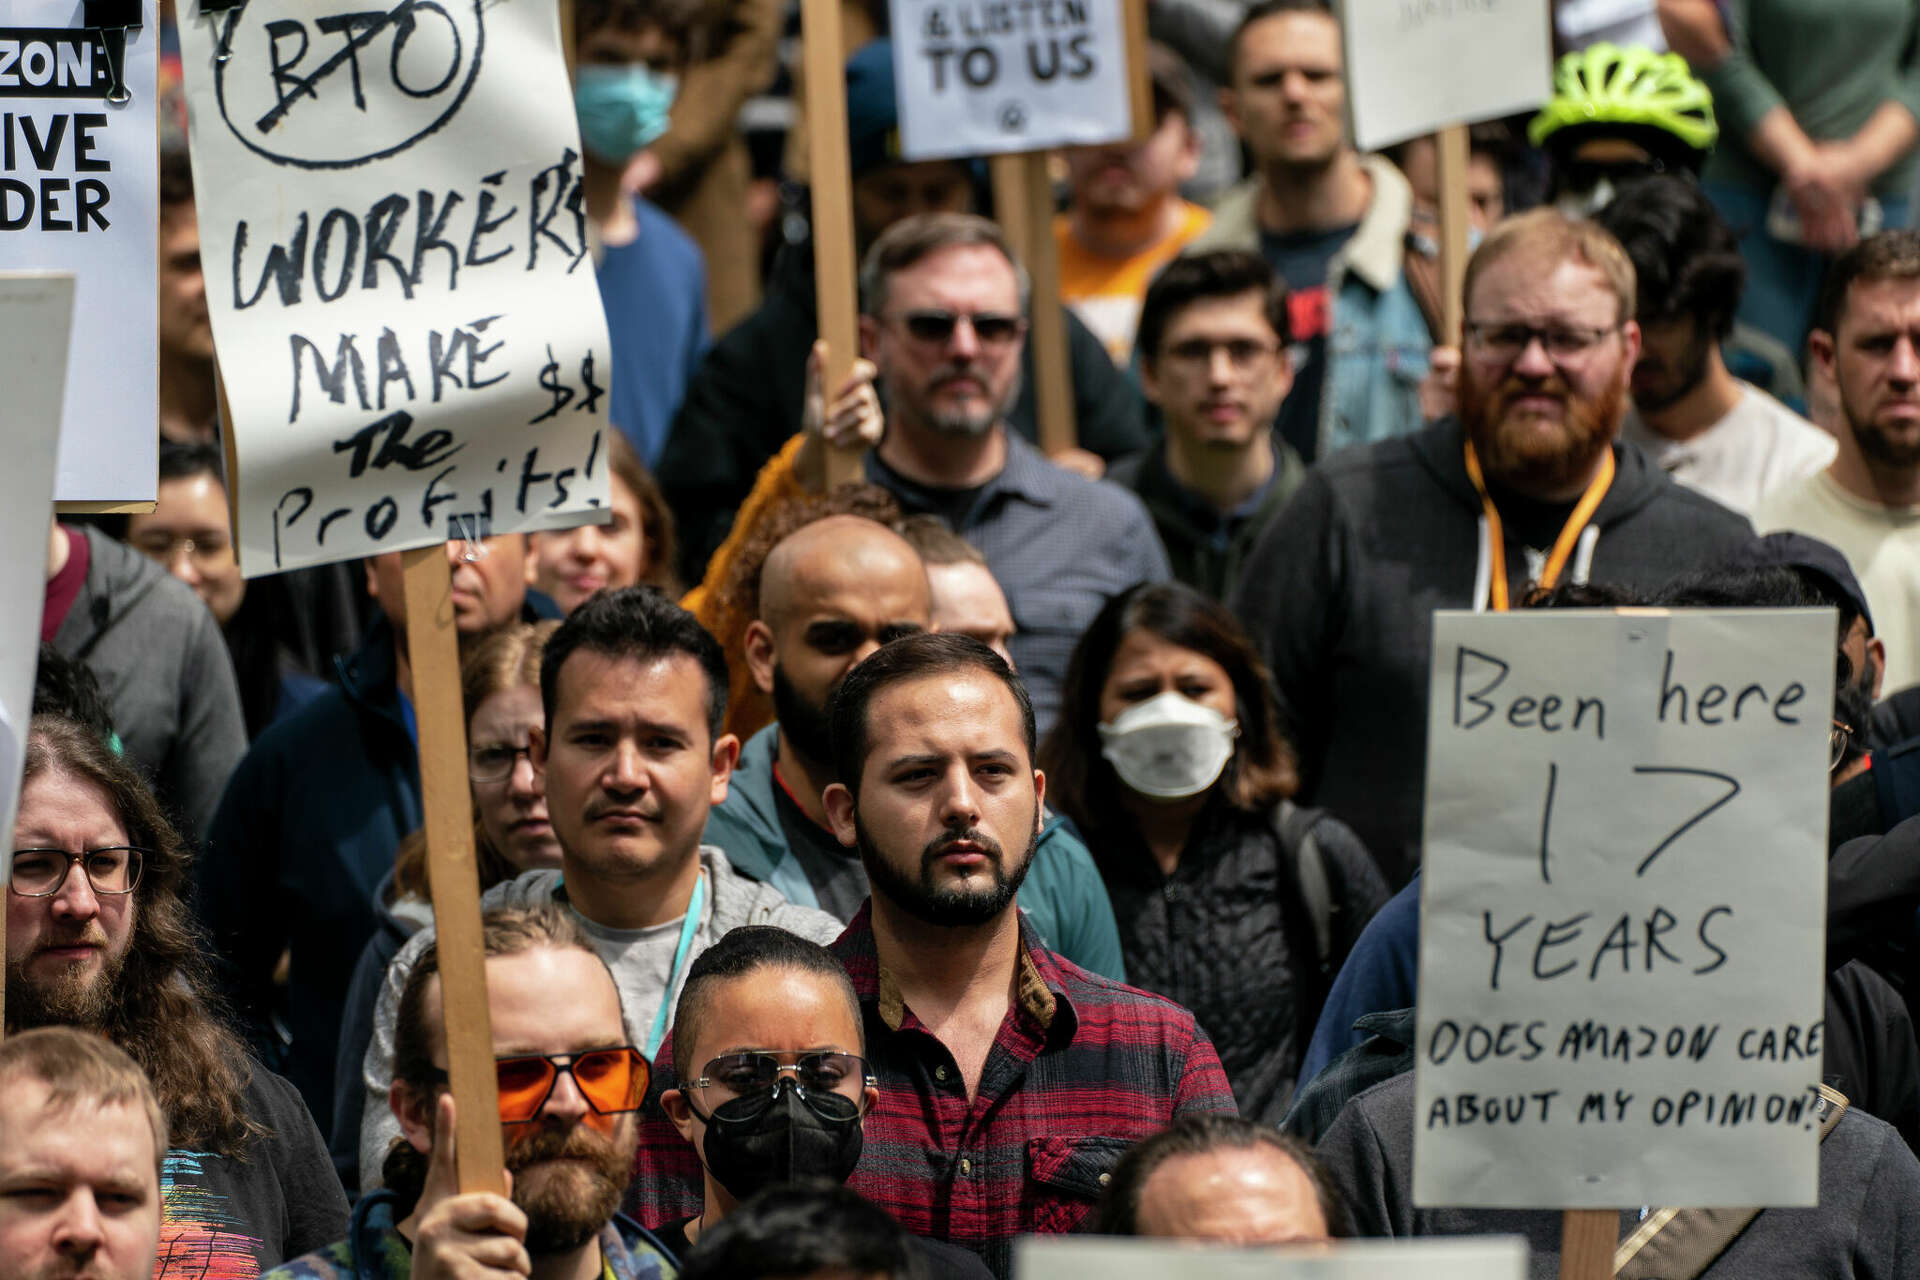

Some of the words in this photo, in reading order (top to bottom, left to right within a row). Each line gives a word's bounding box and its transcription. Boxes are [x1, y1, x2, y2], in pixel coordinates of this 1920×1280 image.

[921, 44, 998, 92] TO
[1027, 34, 1094, 80] US
[289, 313, 509, 424] MAKE
[333, 409, 467, 478] The
[1453, 646, 1606, 740] Been
[1658, 650, 1806, 724] here
[1539, 761, 1741, 885] 17
[1483, 906, 1734, 990] YEARS
[1428, 1020, 1546, 1065] DOES
[1738, 1022, 1825, 1061] CARE
[1428, 1089, 1559, 1129] ABOUT
[1577, 1090, 1635, 1124] MY
[1652, 1085, 1819, 1132] OPINION?
